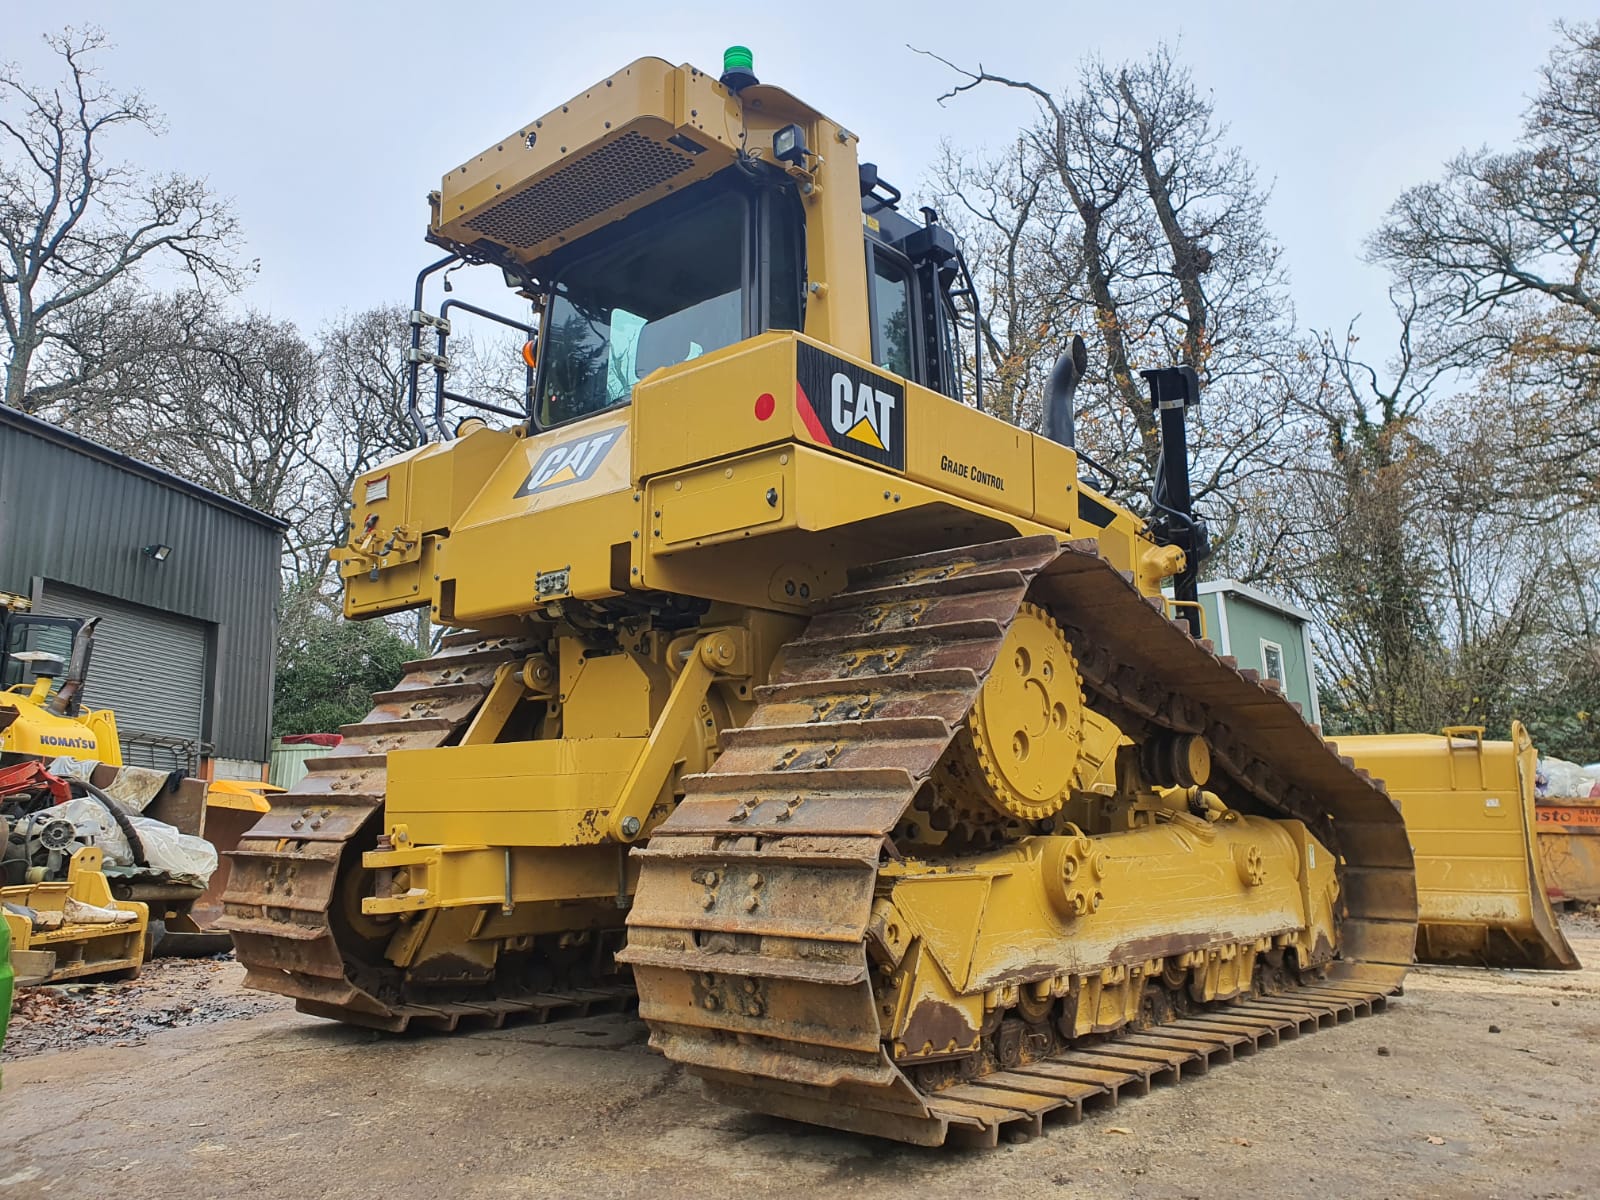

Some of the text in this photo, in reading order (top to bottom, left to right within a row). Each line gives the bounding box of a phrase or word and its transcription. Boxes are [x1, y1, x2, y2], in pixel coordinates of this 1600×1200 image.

[831, 372, 895, 452] CAT
[527, 433, 614, 490] CAT
[40, 735, 96, 750] KOMATSU
